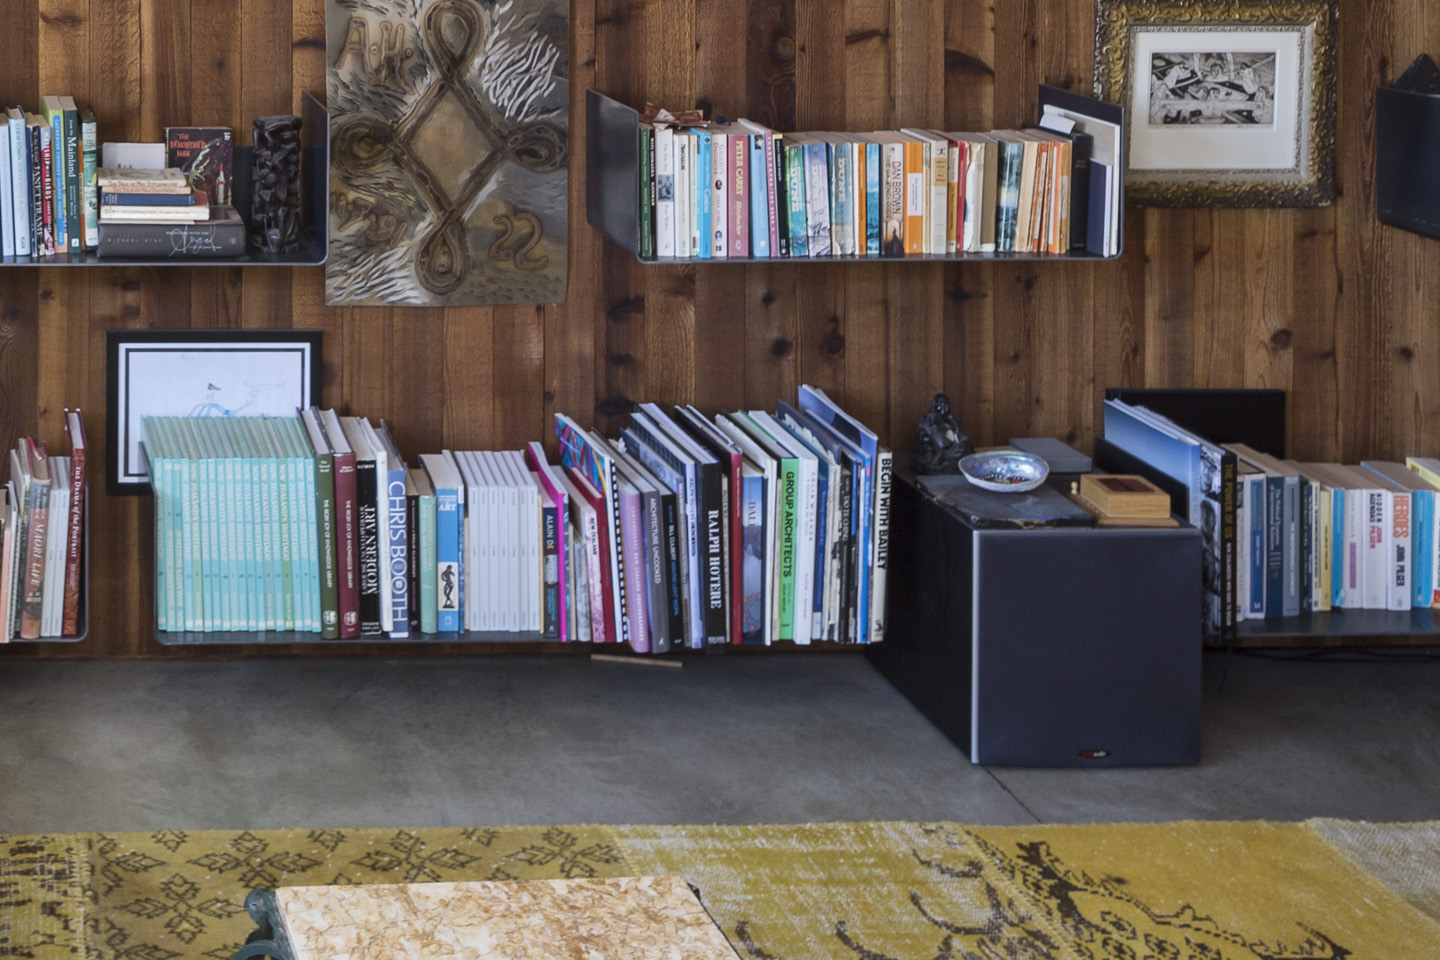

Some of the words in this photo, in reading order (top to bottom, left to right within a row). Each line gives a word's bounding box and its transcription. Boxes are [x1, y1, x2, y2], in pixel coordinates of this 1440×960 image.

[33, 165, 41, 198] JANET
[893, 161, 901, 179] DAN
[893, 182, 901, 214] BROWN
[34, 201, 43, 237] FRAME
[880, 458, 891, 500] BEGIN
[1225, 464, 1233, 480] THE
[73, 482, 81, 504] DRAMA
[785, 472, 795, 509] GROUP
[1225, 482, 1233, 512] POWER
[365, 504, 375, 532] ART
[389, 481, 404, 540] CHRIS
[650, 498, 659, 545] ARCHITECTURE
[879, 505, 890, 526] WITH
[1225, 514, 1233, 524] OF
[1393, 495, 1409, 538] HEROES
[33, 523, 44, 557] MAORI
[71, 526, 79, 557] PORTRAIT
[546, 540, 554, 548] DE
[708, 510, 719, 552] RALPH
[783, 511, 794, 577] ARCHITECTS
[1225, 527, 1233, 538] US
[367, 535, 377, 594] MODERN
[652, 547, 661, 584] UNCOOKED
[877, 530, 888, 569] BAILEY
[1396, 544, 1405, 562] JOHN
[30, 563, 40, 585] LIFE
[390, 545, 407, 621] BOOTH
[709, 556, 721, 608] HOTERE
[1396, 565, 1405, 587] PILGER
